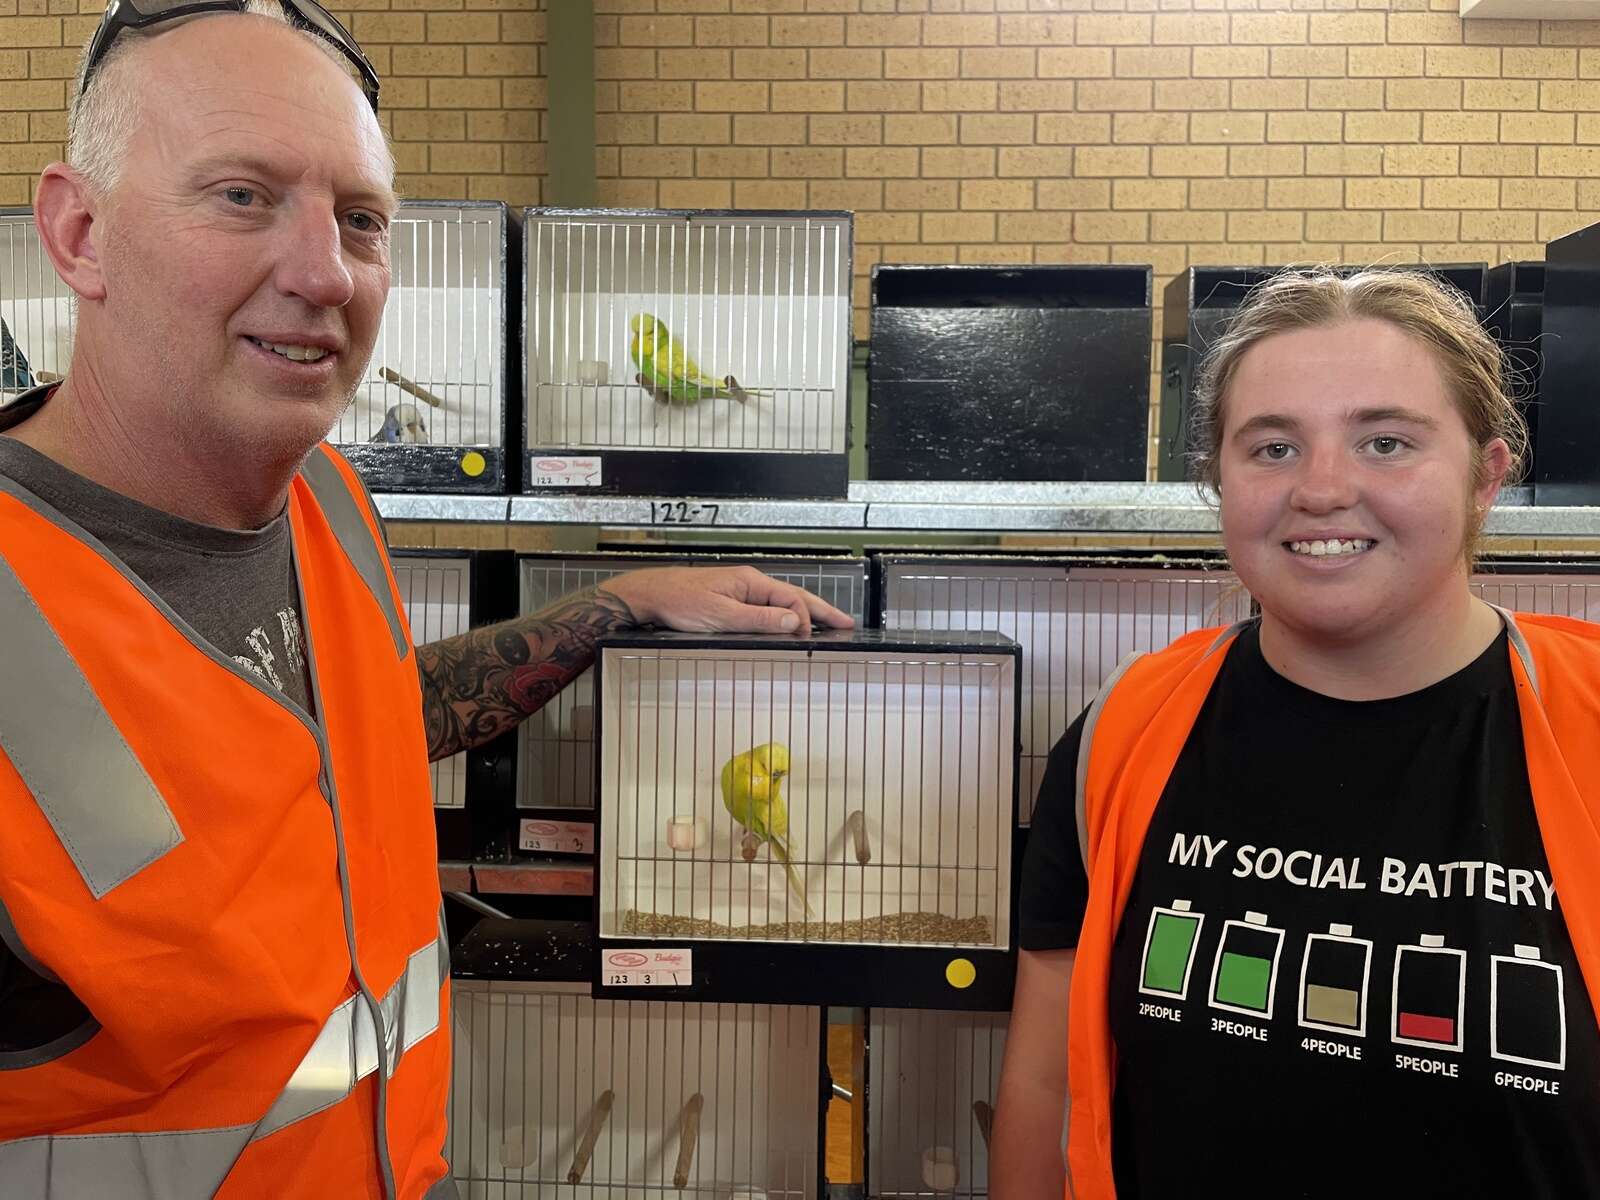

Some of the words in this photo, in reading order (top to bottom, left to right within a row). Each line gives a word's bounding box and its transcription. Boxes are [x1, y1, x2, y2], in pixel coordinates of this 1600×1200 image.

[537, 476, 552, 485] 122
[651, 501, 719, 525] 122-7
[1168, 832, 1228, 869] MY
[1231, 844, 1367, 890] SOCIAL
[1380, 856, 1556, 911] BATTERY
[610, 974, 628, 985] 123
[643, 974, 651, 985] 3
[1138, 1003, 1182, 1023] 2PEOPLE
[1210, 1018, 1268, 1042] 3PEOPLE
[1301, 1037, 1362, 1061] 4PEOPLE
[1395, 1054, 1459, 1078] 5PEOPLE
[1493, 1071, 1560, 1096] 6PEOPLE
